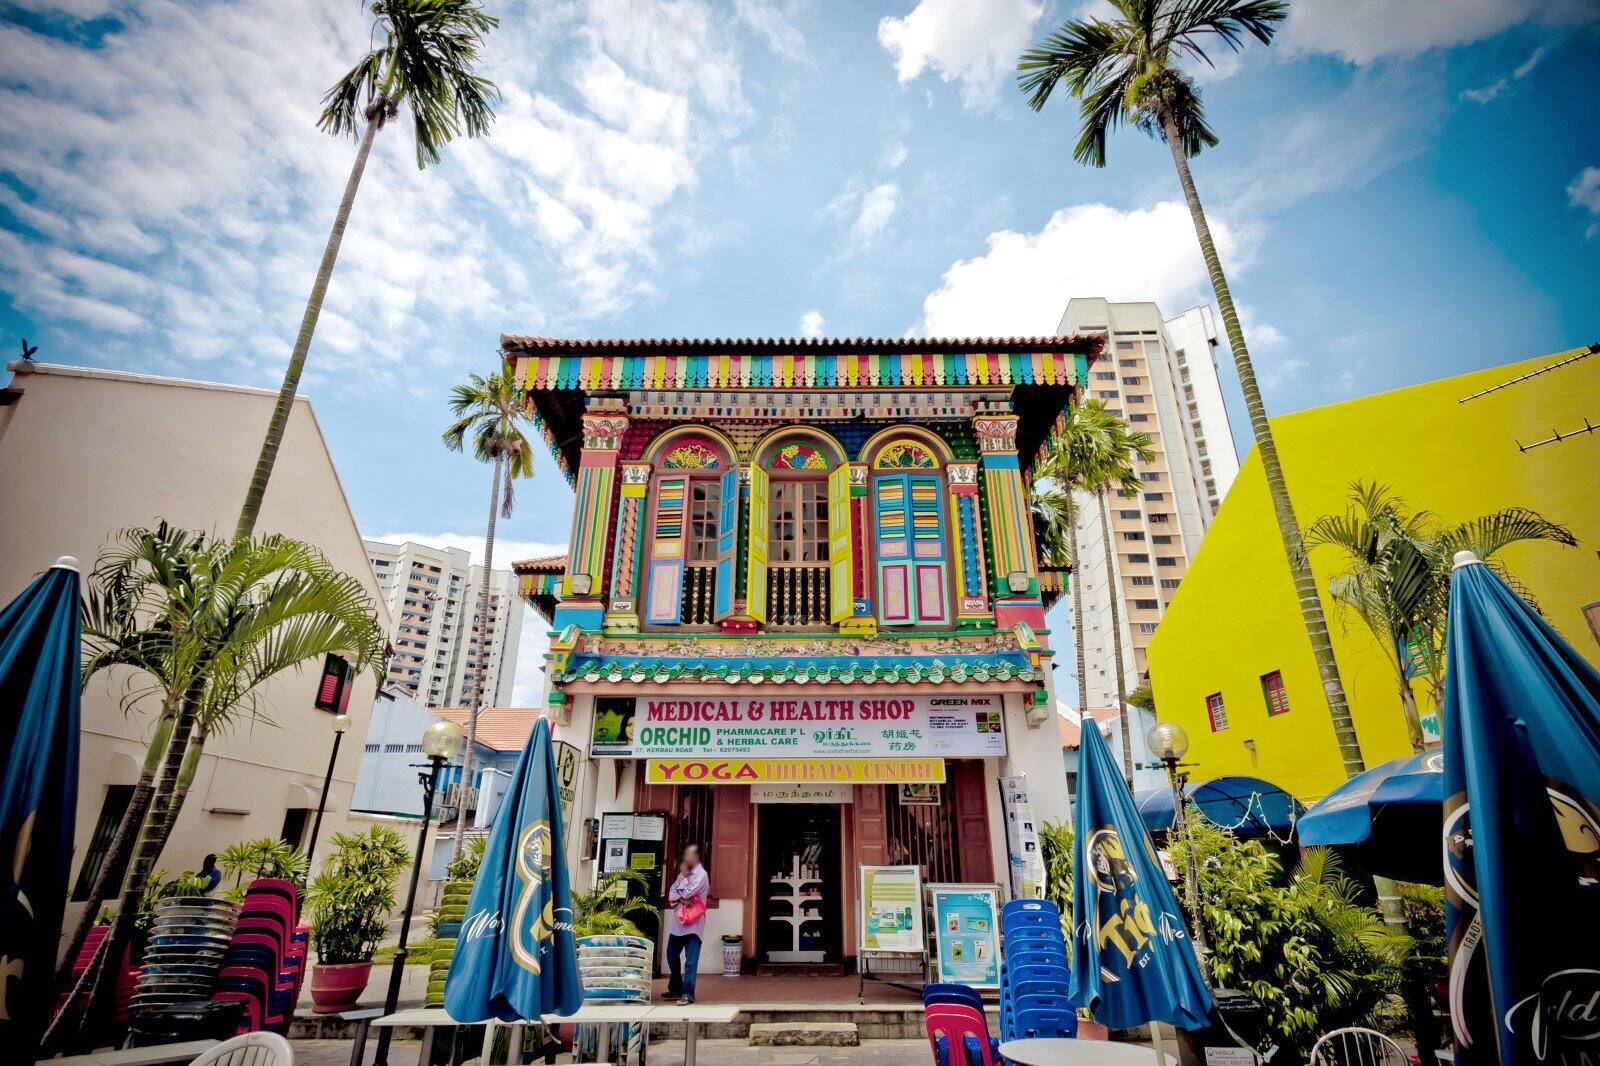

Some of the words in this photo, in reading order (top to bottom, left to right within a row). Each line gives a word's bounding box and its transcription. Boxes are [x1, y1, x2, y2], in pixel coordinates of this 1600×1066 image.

[970, 698, 991, 706] MIX
[646, 701, 743, 722] MEDICAL
[747, 700, 765, 722] &
[769, 700, 855, 721] HEALTH
[859, 699, 916, 721] SHOP
[640, 727, 711, 746] ORCHID
[716, 728, 787, 736] PHARMACARE
[881, 729, 922, 739] 胡姬花
[727, 738, 767, 746] HERBAL
[888, 741, 917, 751] 药房
[658, 762, 759, 781] YOGA
[763, 762, 856, 781] THERAPY
[863, 762, 935, 780] CENTRE
[1463, 918, 1483, 950] TRADE
